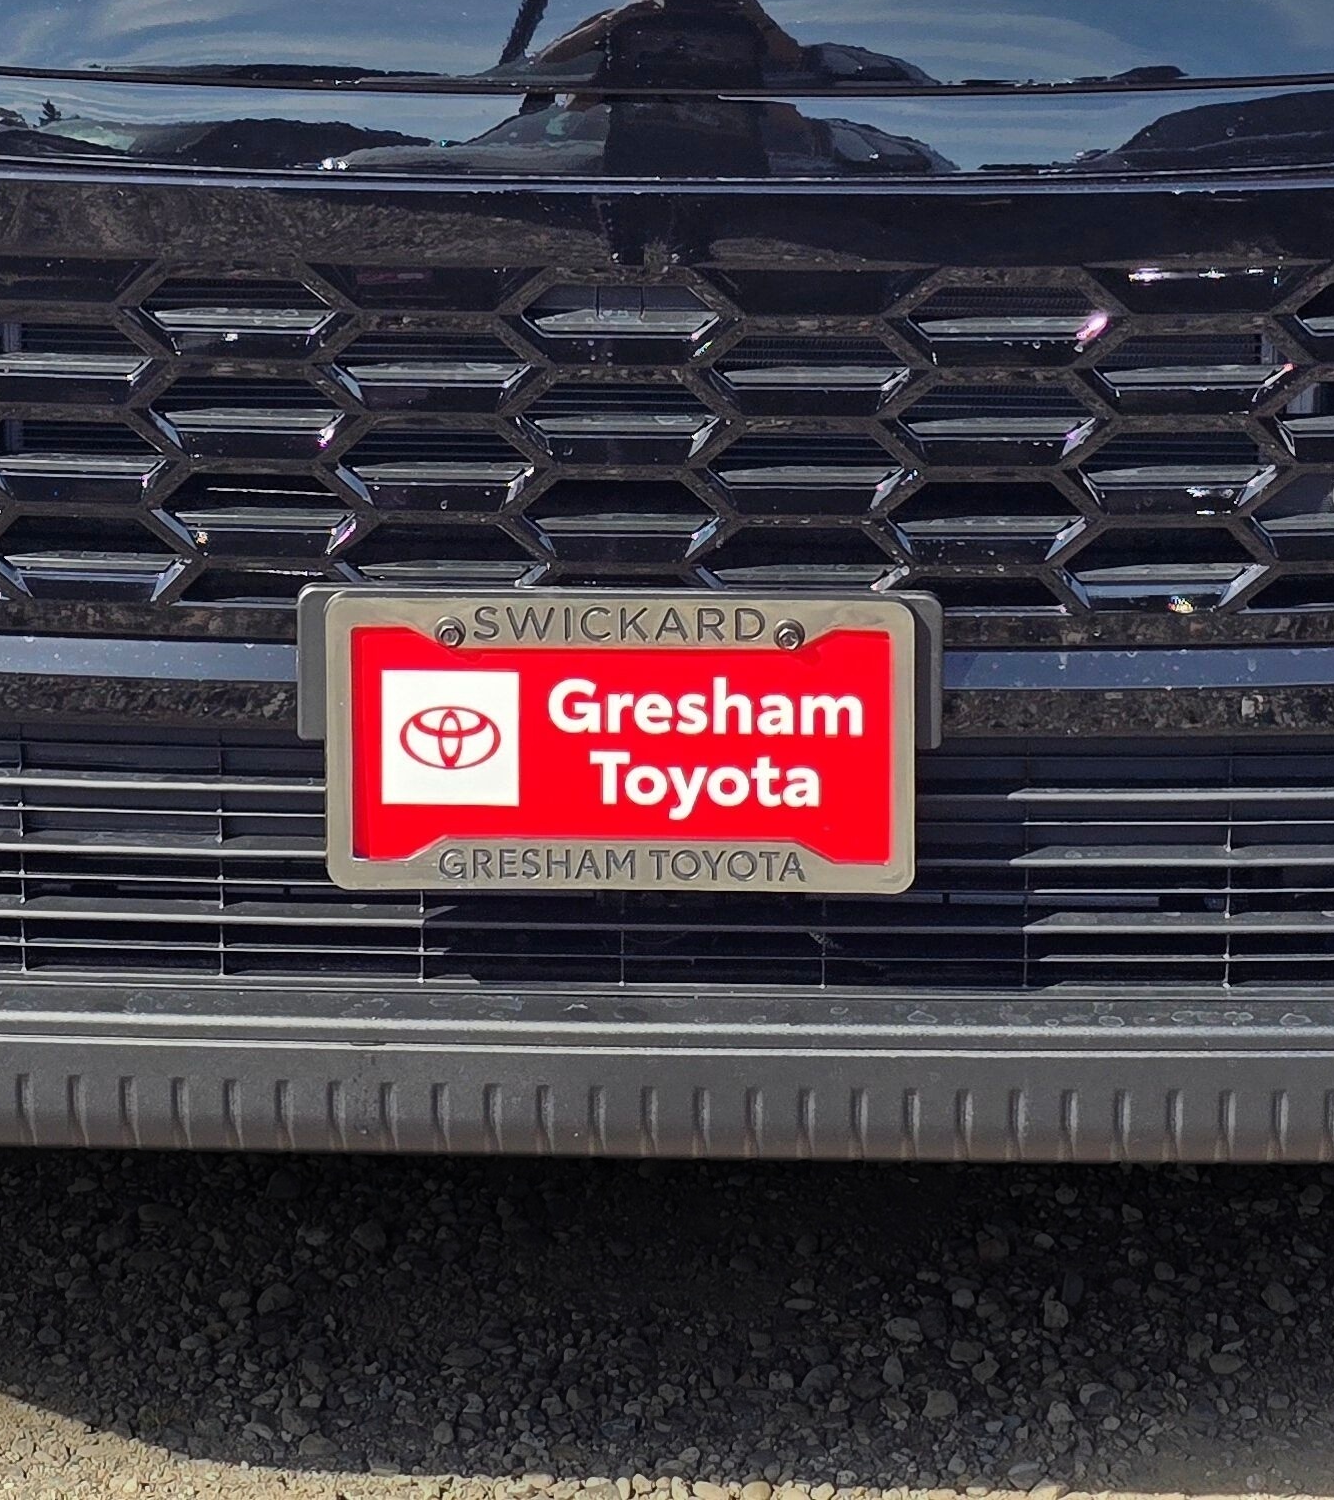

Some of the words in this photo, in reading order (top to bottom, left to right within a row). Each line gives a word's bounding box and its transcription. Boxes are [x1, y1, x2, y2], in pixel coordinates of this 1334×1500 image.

[472, 605, 766, 643] SWICKARD
[548, 676, 864, 737] Gresham
[589, 749, 821, 821] Toyota
[438, 847, 637, 881] GRESHAM
[648, 849, 807, 883] TOYOTA
